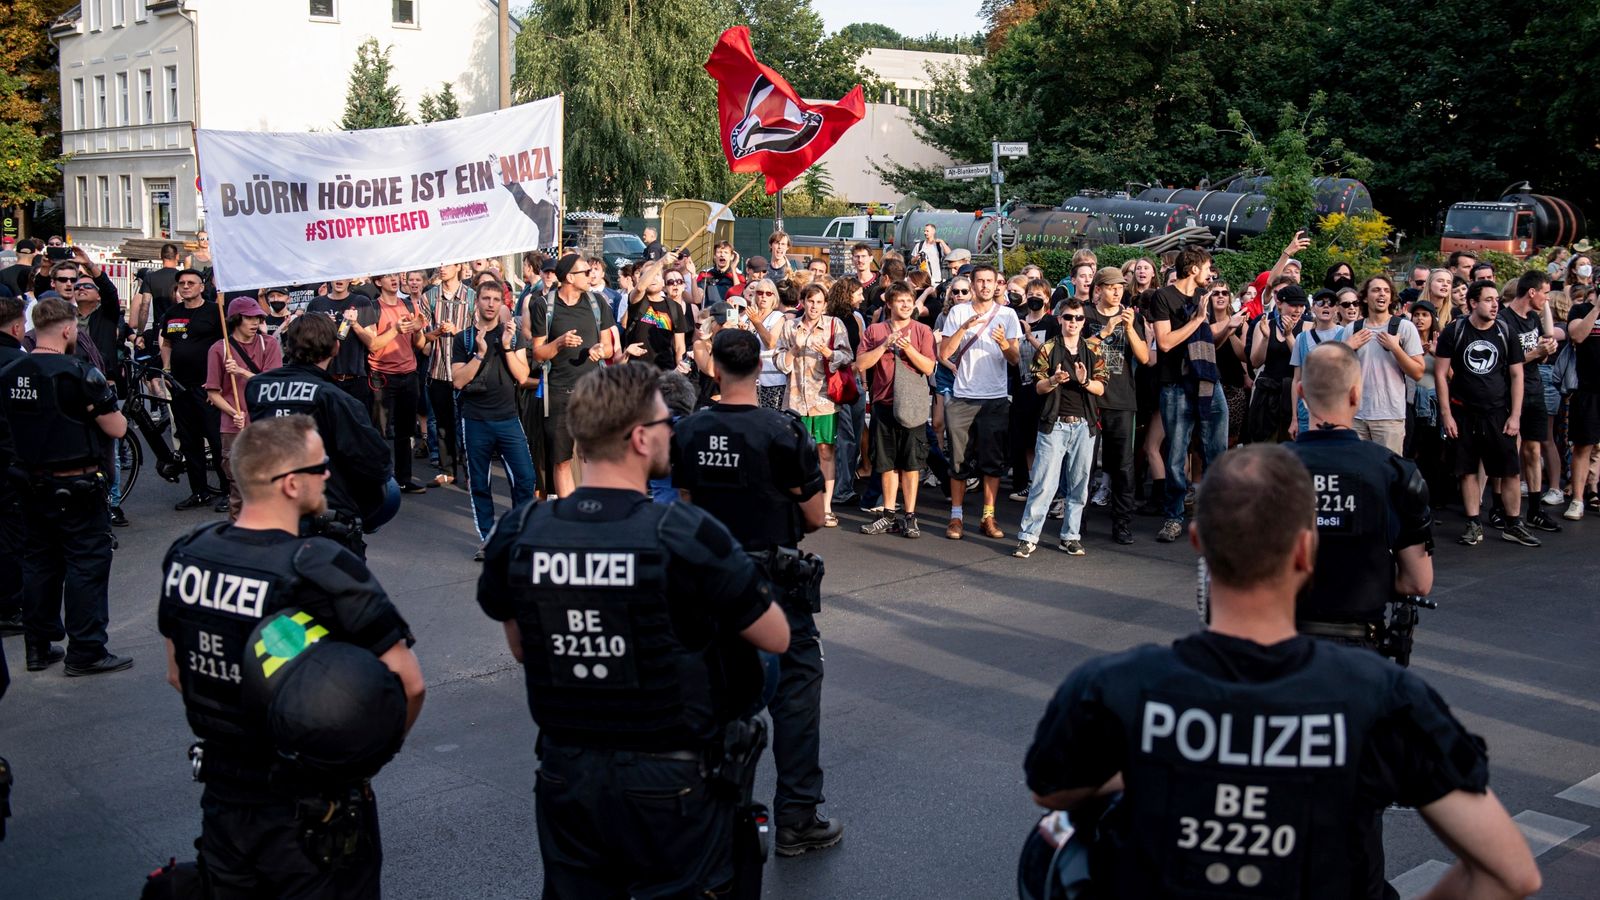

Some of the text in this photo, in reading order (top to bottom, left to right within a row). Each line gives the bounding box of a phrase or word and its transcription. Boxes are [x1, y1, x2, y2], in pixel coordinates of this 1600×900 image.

[221, 146, 554, 217] BJÖRN HÖCKE IST EIN NAZI
[948, 167, 989, 175] Alt-Blankenburg
[305, 209, 430, 242] #STOPPTDIEAFD
[10, 388, 38, 400] 32224
[17, 377, 30, 388] BE
[257, 381, 319, 403] POLIZEI
[709, 435, 729, 451] BE
[698, 451, 740, 467] 32217
[1314, 475, 1339, 492] BE
[1317, 517, 1340, 526] BeSi
[532, 552, 635, 586] POLIZEI
[165, 562, 269, 618] POLIZEI
[567, 609, 603, 633] BE
[199, 630, 224, 656] BE
[551, 634, 626, 657] 32110
[189, 651, 243, 684] 32114
[1141, 700, 1347, 767] POLIZEI
[1215, 783, 1269, 819] BE
[1177, 816, 1296, 857] 32220
